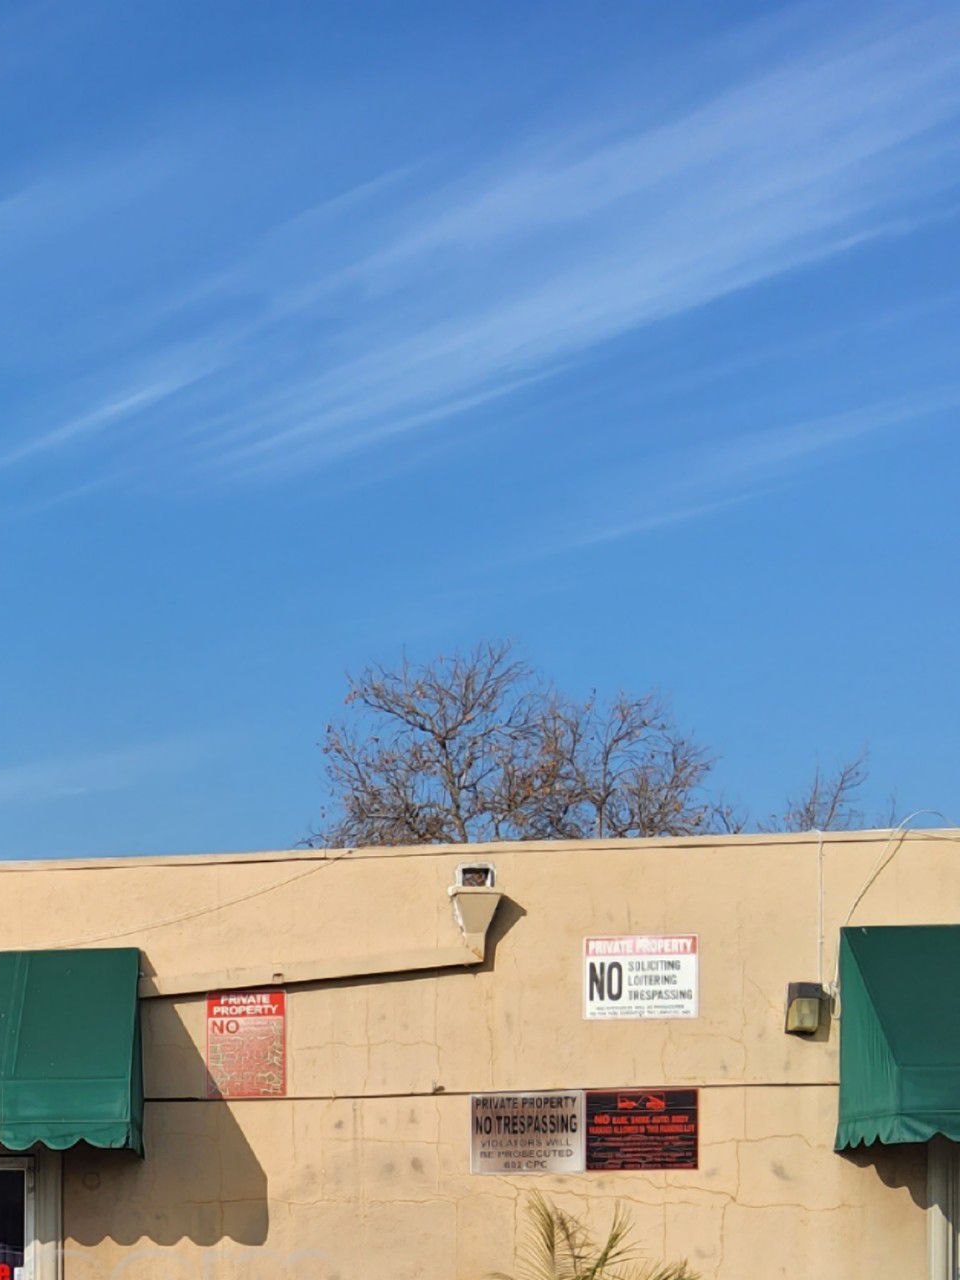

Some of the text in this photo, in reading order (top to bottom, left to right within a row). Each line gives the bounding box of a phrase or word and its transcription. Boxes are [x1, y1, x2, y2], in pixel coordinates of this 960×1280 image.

[589, 938, 692, 955] PRIVATE PROPERTY
[628, 960, 681, 972] SOLICITING
[589, 961, 623, 1002] NO
[628, 974, 677, 986] LOITERING
[221, 993, 269, 1005] PRIVATE
[628, 989, 692, 1001] TRESPASSING
[213, 1004, 278, 1016] PROPERTY
[212, 1019, 240, 1034] NO
[476, 1096, 576, 1109] PRIVATE PROPERTY
[475, 1115, 492, 1135] NO
[496, 1114, 577, 1134] TRESPASSING
[481, 1138, 572, 1148] VIOLATORS WILL
[498, 1149, 573, 1158] PROSECUTED
[526, 1160, 547, 1169] CPC
